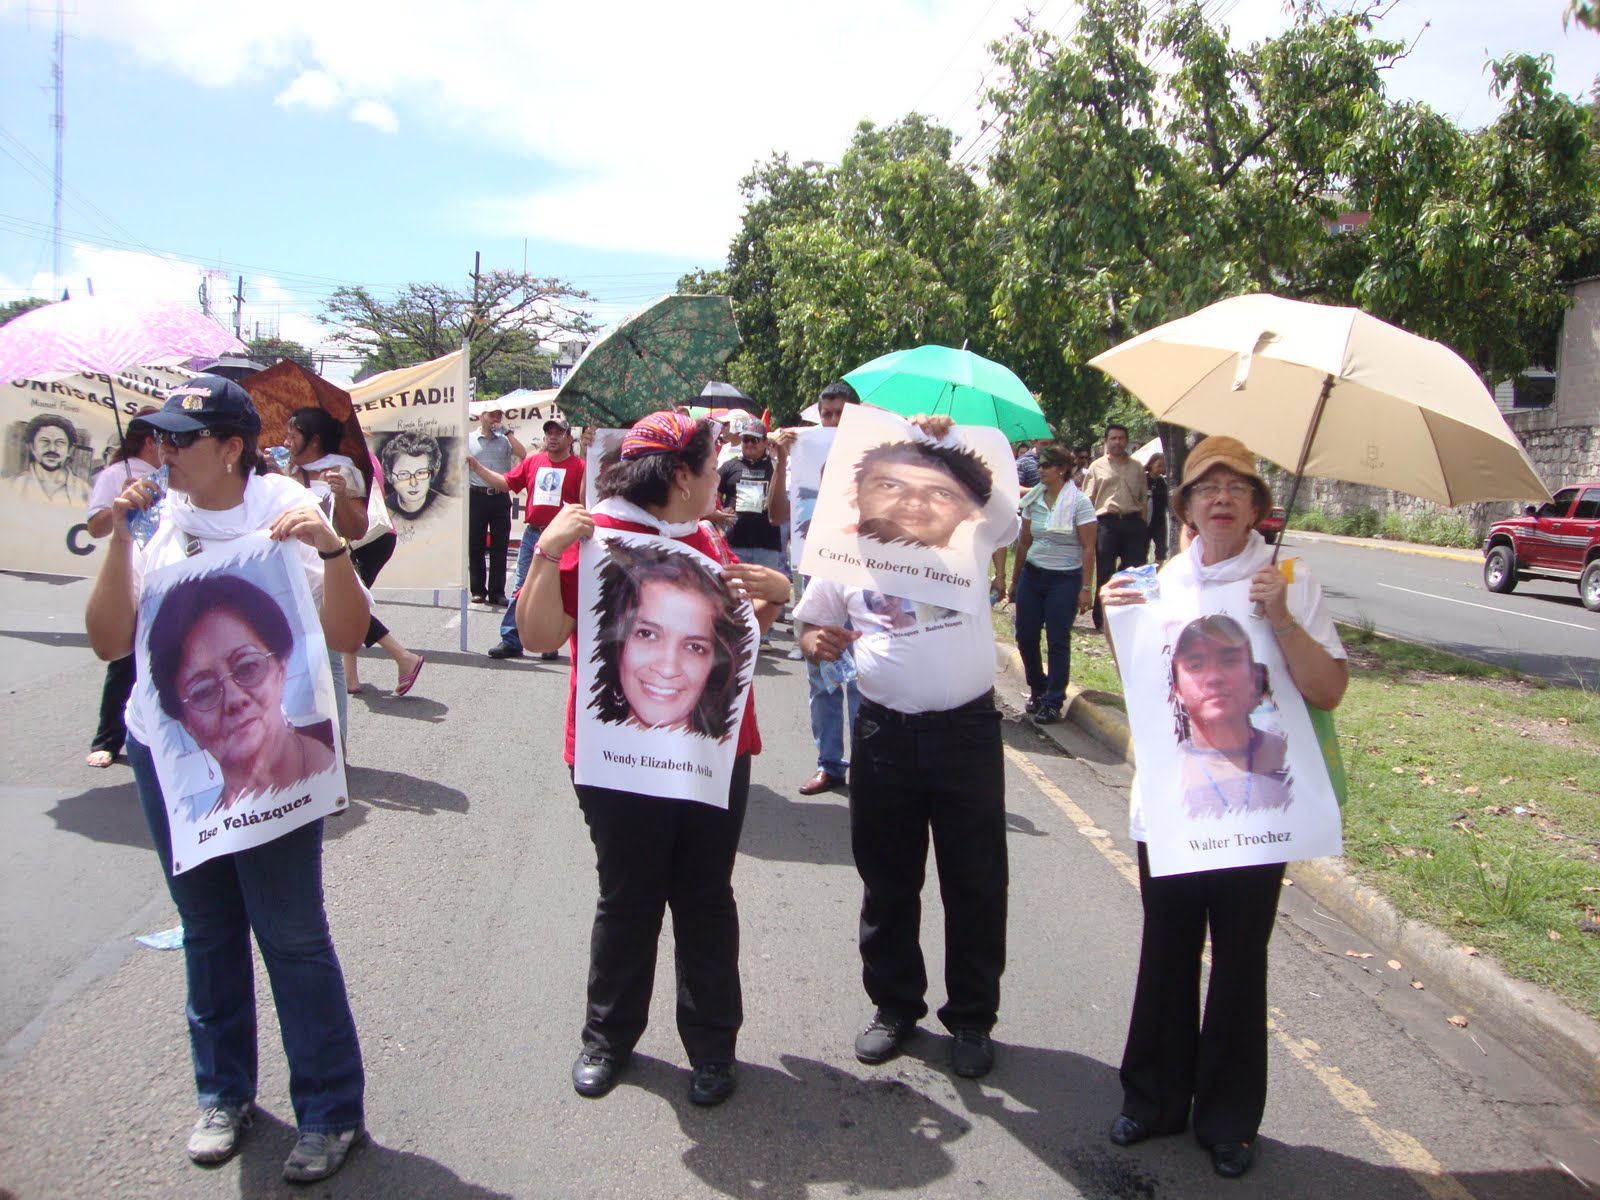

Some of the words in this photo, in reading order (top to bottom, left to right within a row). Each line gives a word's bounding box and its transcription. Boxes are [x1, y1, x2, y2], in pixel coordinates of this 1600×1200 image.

[818, 547, 862, 567] Carlos
[865, 558, 919, 576] Roberto
[923, 566, 972, 588] Turcios
[602, 750, 638, 768] Wendy
[640, 755, 693, 773] Elizabeth
[198, 826, 218, 844] Ilse
[223, 793, 312, 831] Velázquez
[1188, 838, 1230, 851] Walter
[1233, 830, 1293, 846] Trochez
